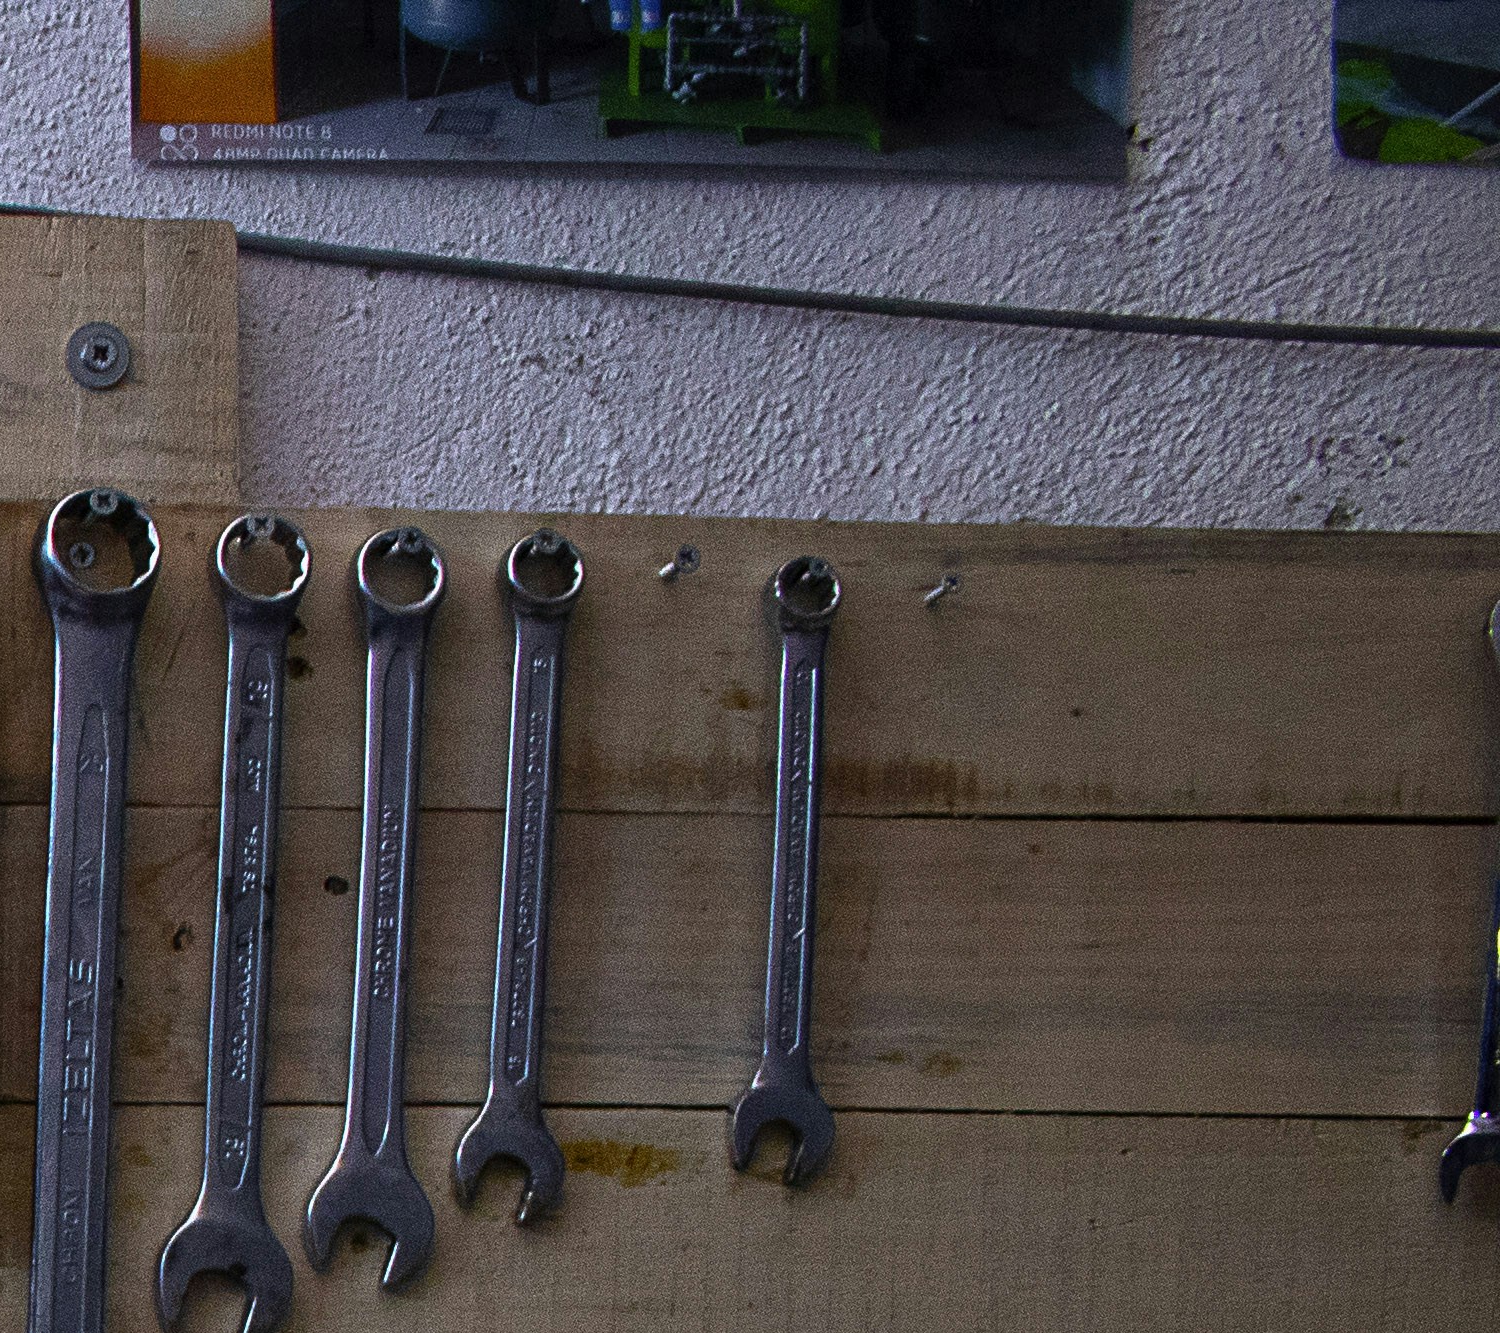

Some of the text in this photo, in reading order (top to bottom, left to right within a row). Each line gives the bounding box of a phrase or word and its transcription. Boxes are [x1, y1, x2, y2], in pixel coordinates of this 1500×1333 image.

[212, 125, 332, 139] REDMI NOTE 8
